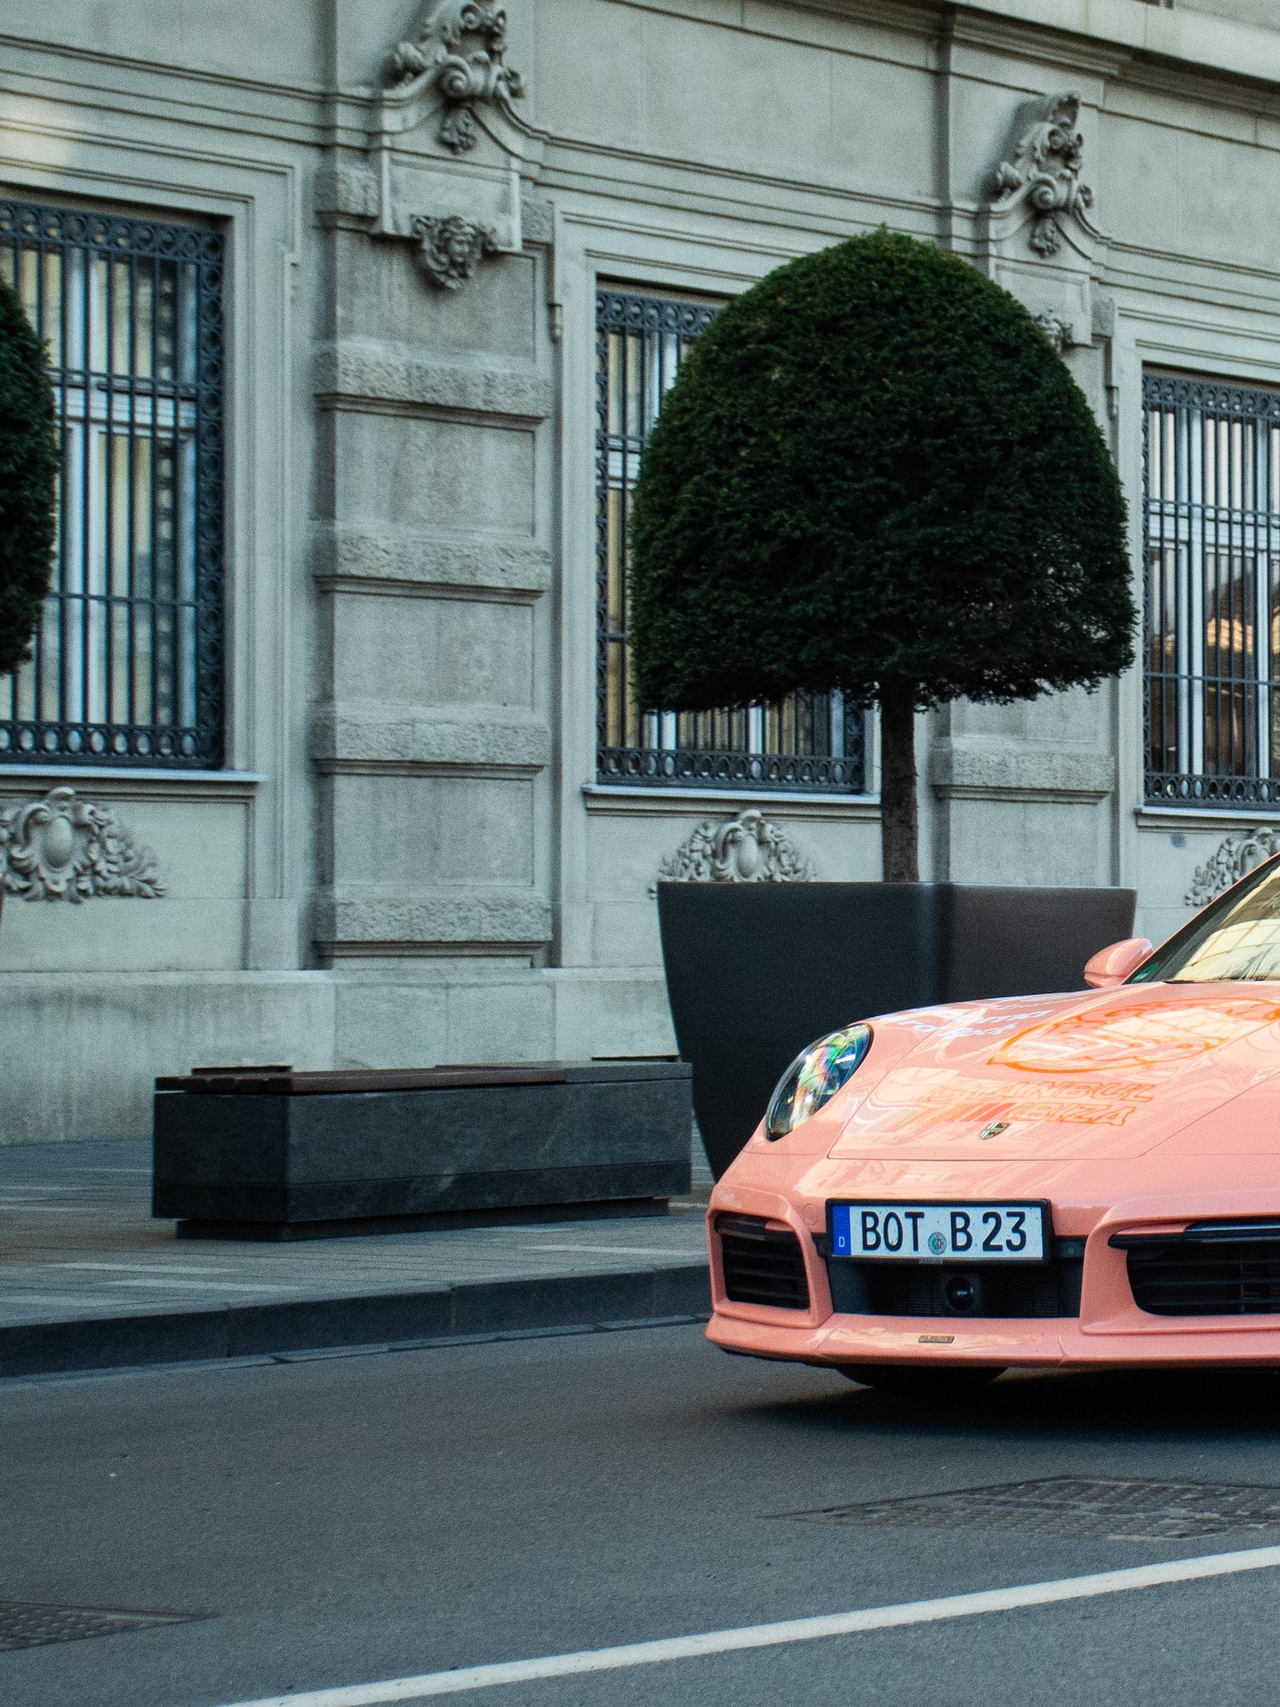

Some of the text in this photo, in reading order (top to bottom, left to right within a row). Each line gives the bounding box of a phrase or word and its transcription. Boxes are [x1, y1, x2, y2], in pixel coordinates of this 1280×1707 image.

[1002, 1102, 1137, 1126] IBIZA
[838, 1236, 846, 1248] D
[861, 1211, 925, 1251] BOT
